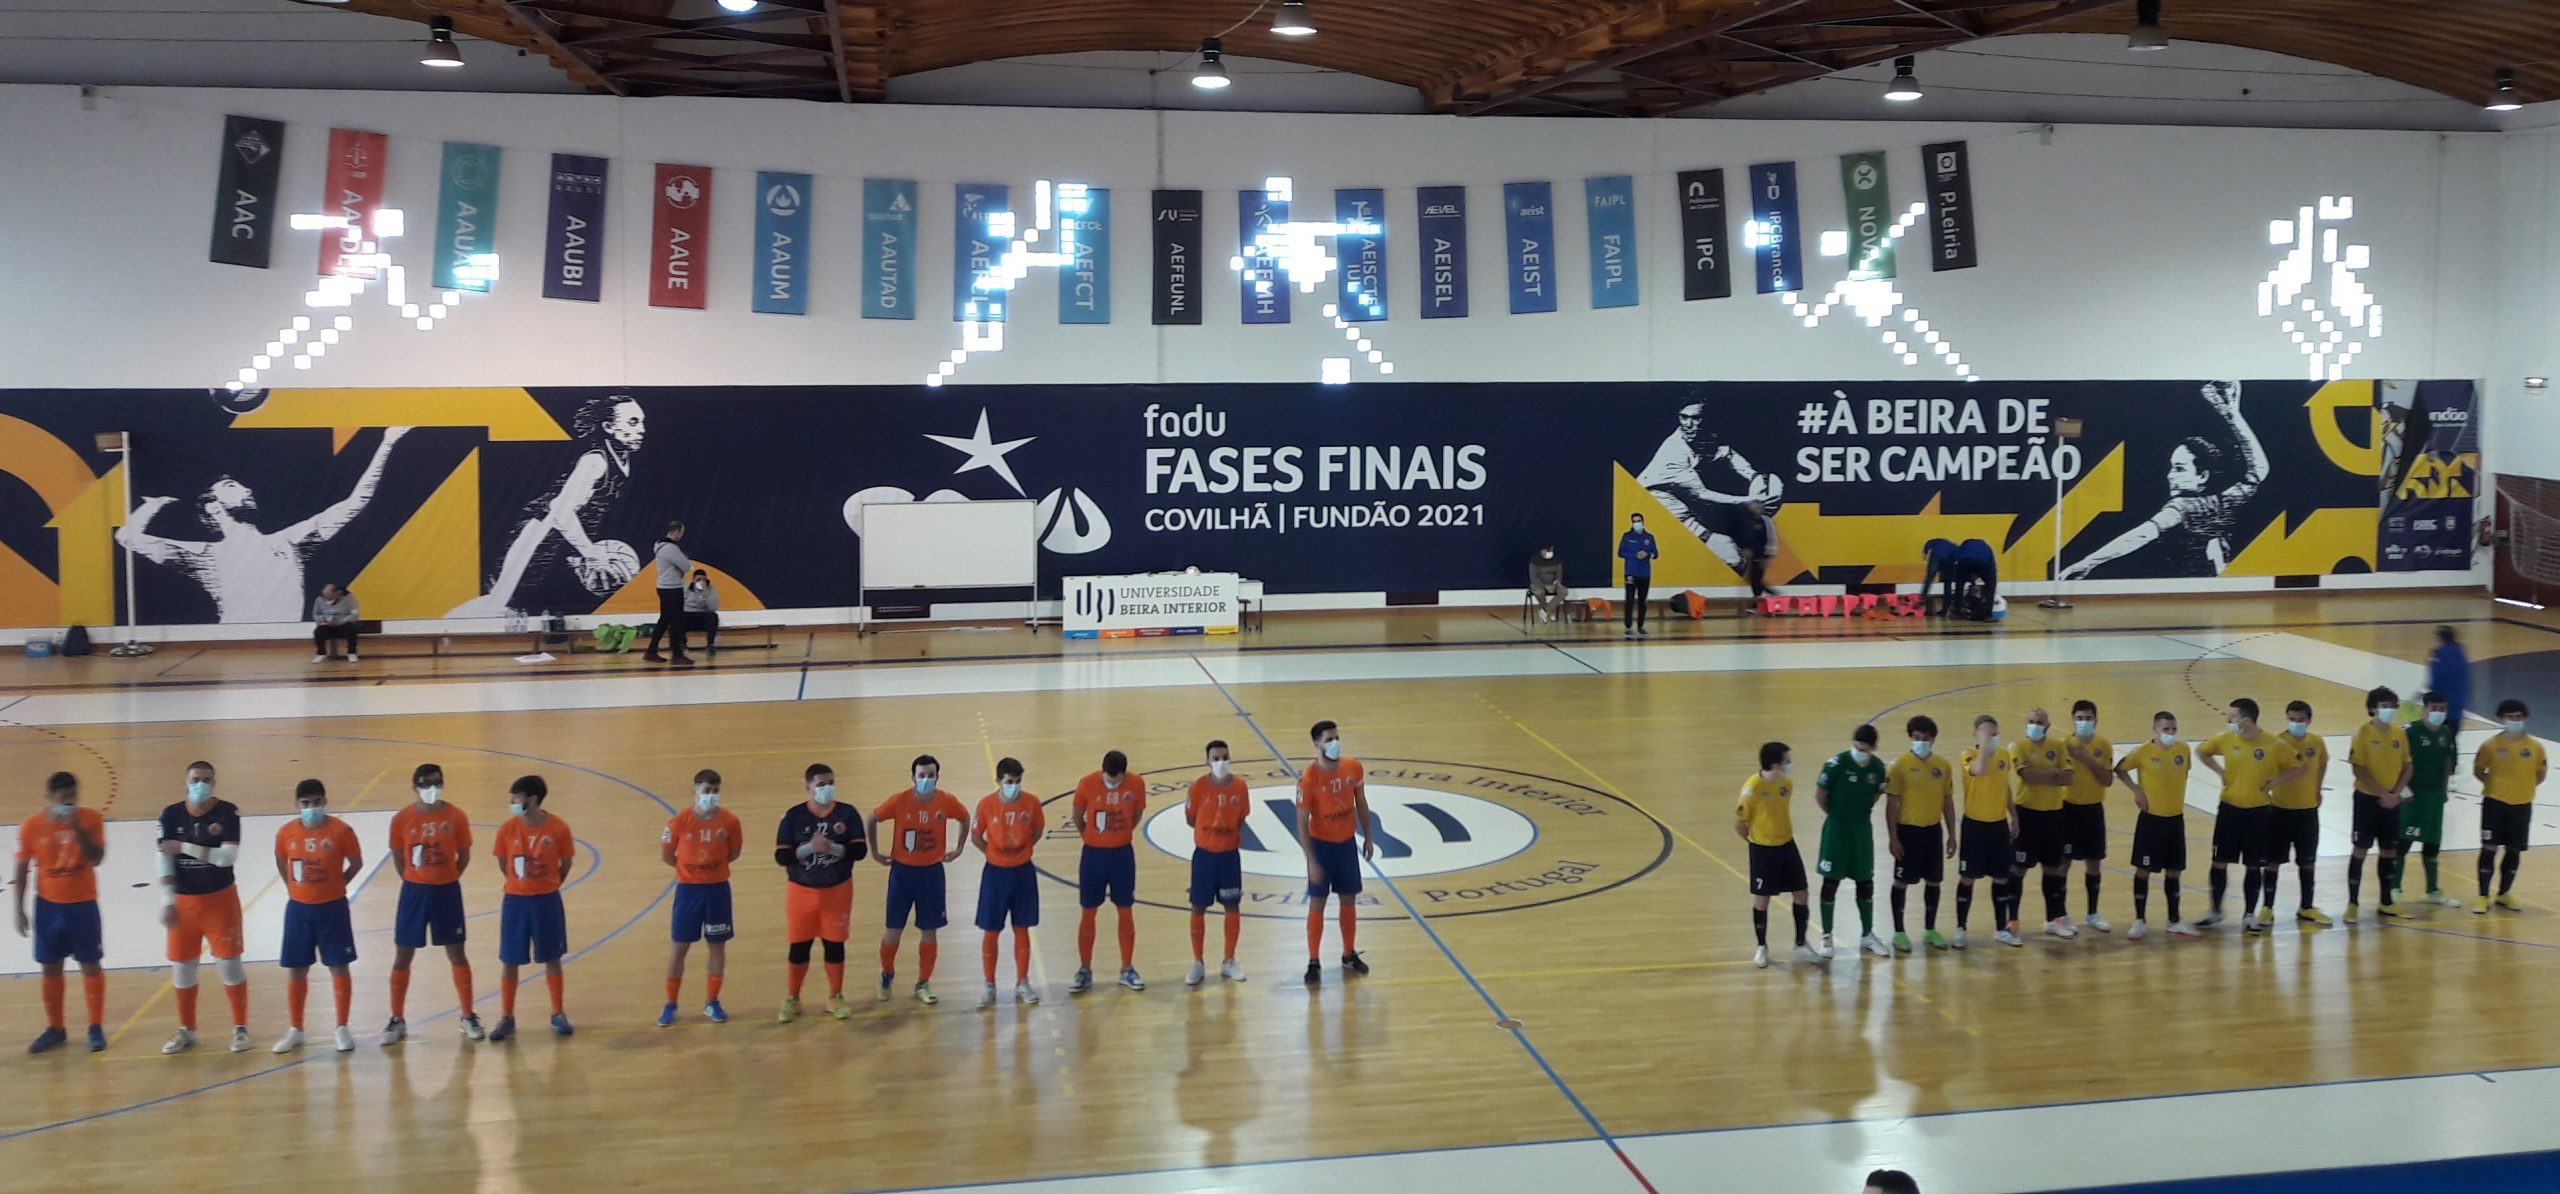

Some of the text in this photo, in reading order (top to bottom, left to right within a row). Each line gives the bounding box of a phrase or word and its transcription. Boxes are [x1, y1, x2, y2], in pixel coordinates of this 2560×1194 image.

[231, 188, 259, 240] AAC
[1939, 191, 1961, 259] P.Leiria
[562, 214, 588, 286] AAUBI
[667, 227, 691, 290] AAUE
[769, 231, 793, 299] AAUM
[880, 232, 897, 309] AAUTAD
[1434, 237, 1453, 308] AEISEL
[1521, 238, 1541, 296] AEIST
[1603, 234, 1623, 289] FAIPL
[1696, 237, 1715, 271] IPC
[1074, 242, 1094, 311] AEFCT
[1170, 242, 1185, 316] AEFEUNL
[1346, 264, 1361, 292] IU
[1144, 403, 1226, 438] fadu
[1797, 390, 2050, 435] #À BEIRA DE
[1147, 444, 1487, 494] FASES FINAIS
[1796, 436, 2083, 483] SER CAMPEÃO
[1145, 502, 1272, 532] COVILHÃ
[1293, 500, 1411, 529] FUNDÃO
[1418, 504, 1483, 527] 2021
[1120, 585, 1220, 599] UNIVERSIDADE
[1120, 601, 1226, 616] BEIRA INTERIOR
[1367, 768, 1453, 783] eira
[1463, 775, 1608, 818] Interior
[527, 835, 537, 849] 7
[699, 829, 712, 843] 14
[1423, 859, 1601, 904] Portugal
[1755, 877, 1764, 890] 7
